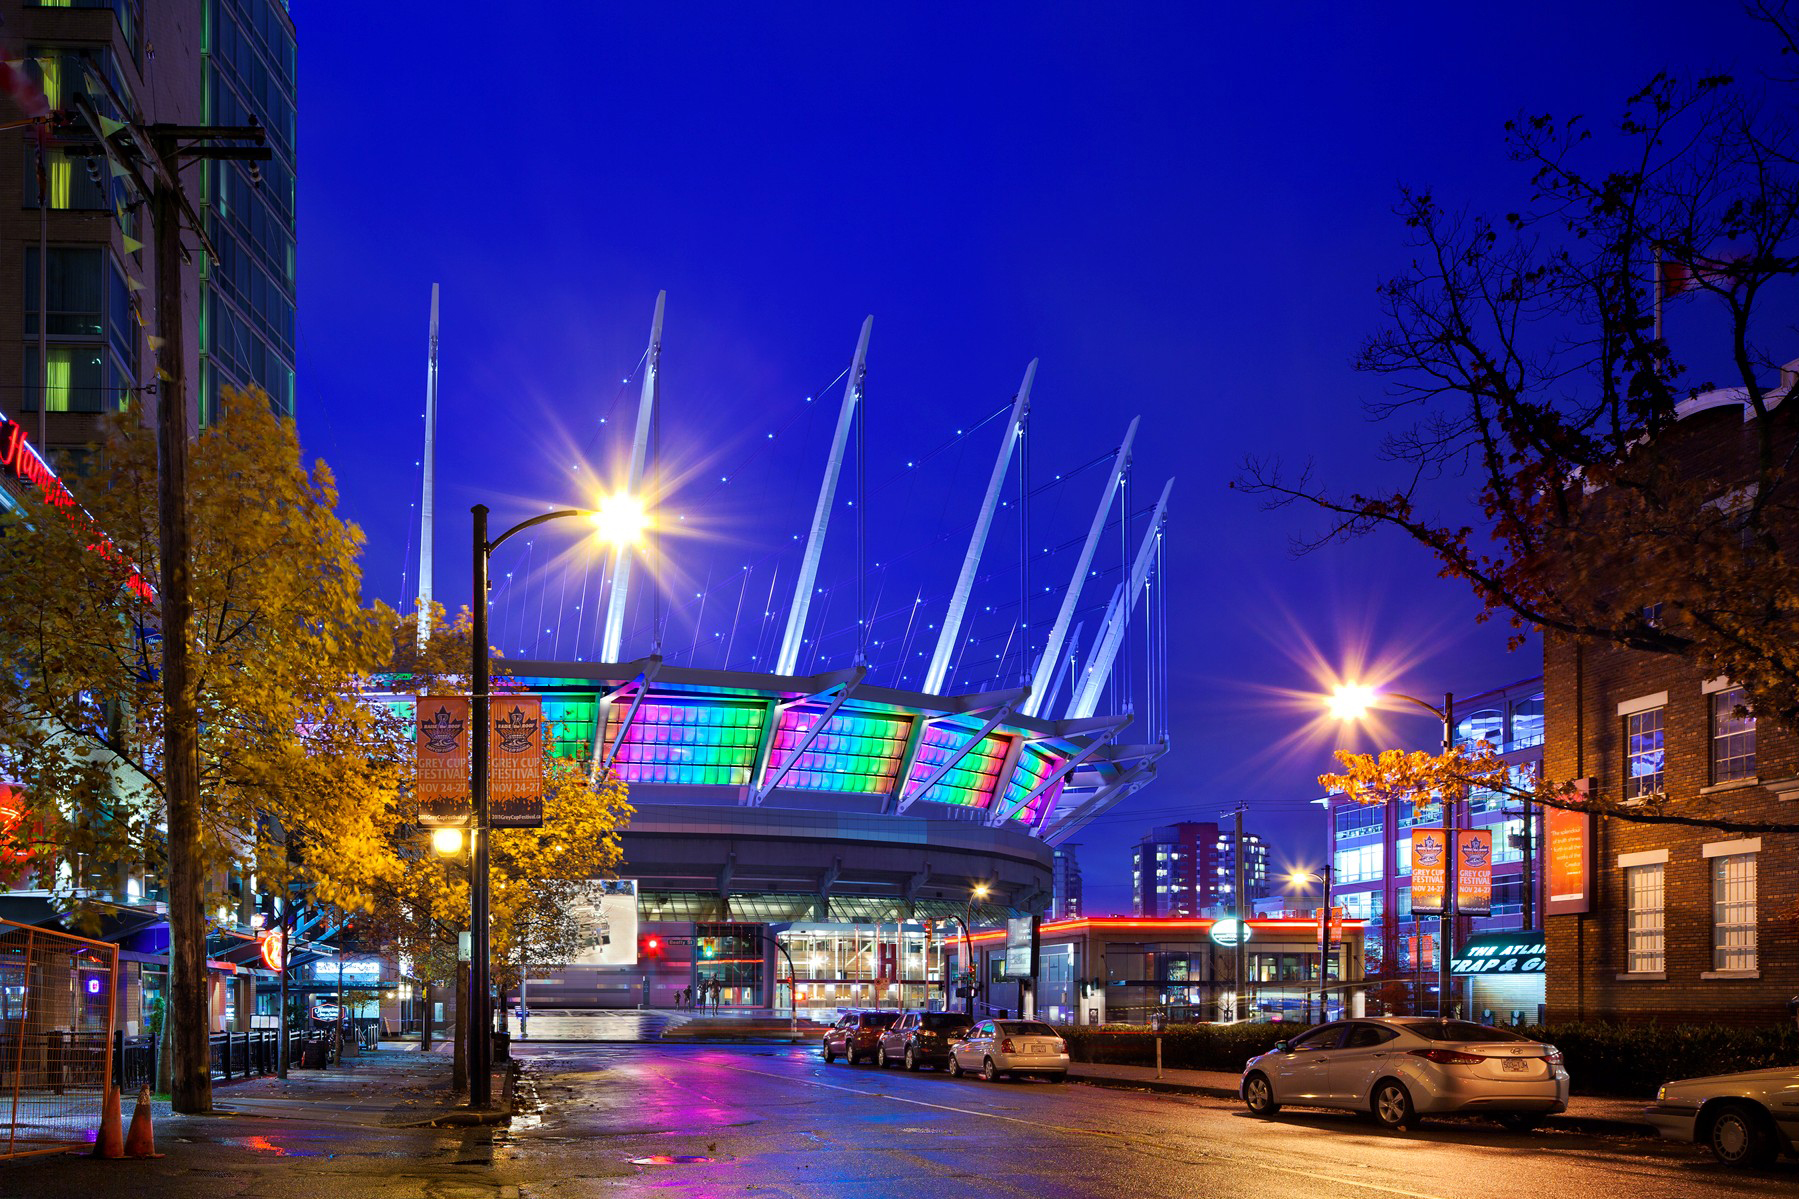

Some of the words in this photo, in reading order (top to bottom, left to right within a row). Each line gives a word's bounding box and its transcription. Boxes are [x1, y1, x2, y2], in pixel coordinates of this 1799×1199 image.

[418, 758, 445, 768] GREY
[447, 758, 466, 768] CUP
[492, 758, 518, 768] GREY
[521, 758, 540, 768] CUP
[418, 768, 466, 779] FESTIVAL
[492, 768, 540, 779] FESTIVAL
[418, 784, 438, 792] NOV
[441, 783, 466, 792] 24-27
[492, 784, 512, 792] NOV
[515, 783, 540, 792] 24-27
[1468, 946, 1498, 957] THE
[1498, 959, 1518, 971] &
